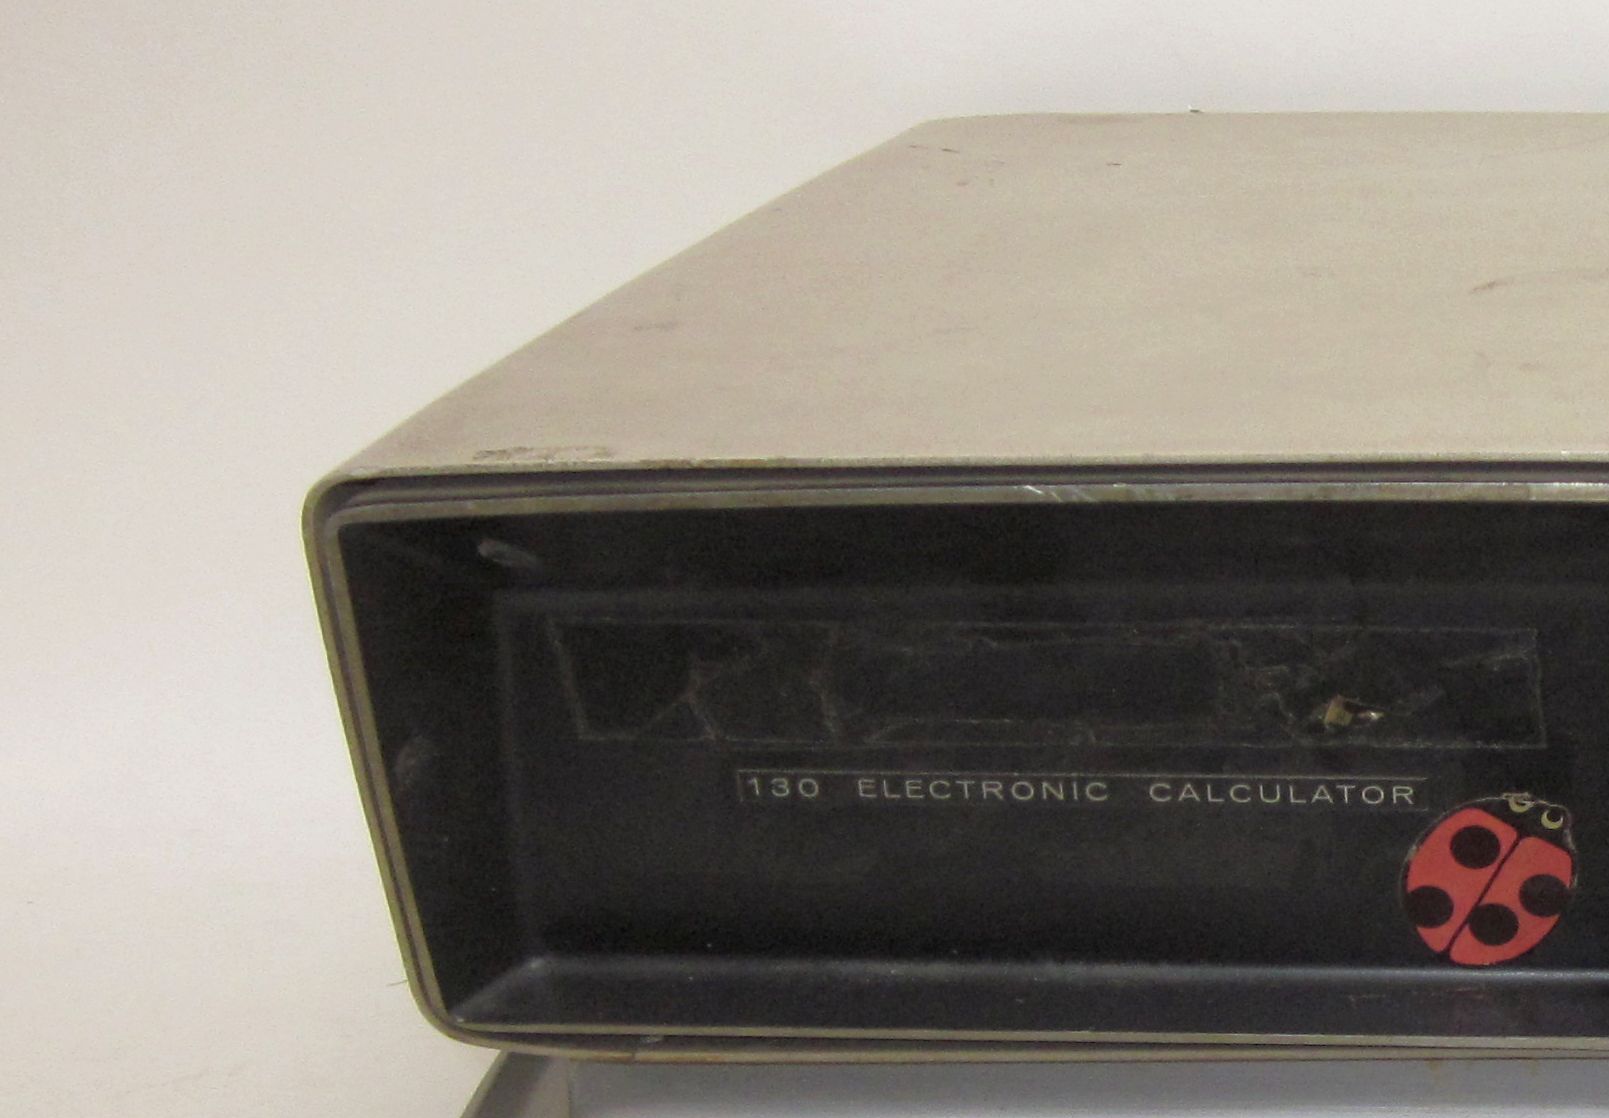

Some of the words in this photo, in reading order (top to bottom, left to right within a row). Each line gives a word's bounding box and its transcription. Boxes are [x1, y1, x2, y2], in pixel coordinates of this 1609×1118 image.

[748, 777, 820, 799] 130
[857, 778, 1107, 802] ELECTRONIC
[1148, 781, 1414, 805] CALCULATOR
